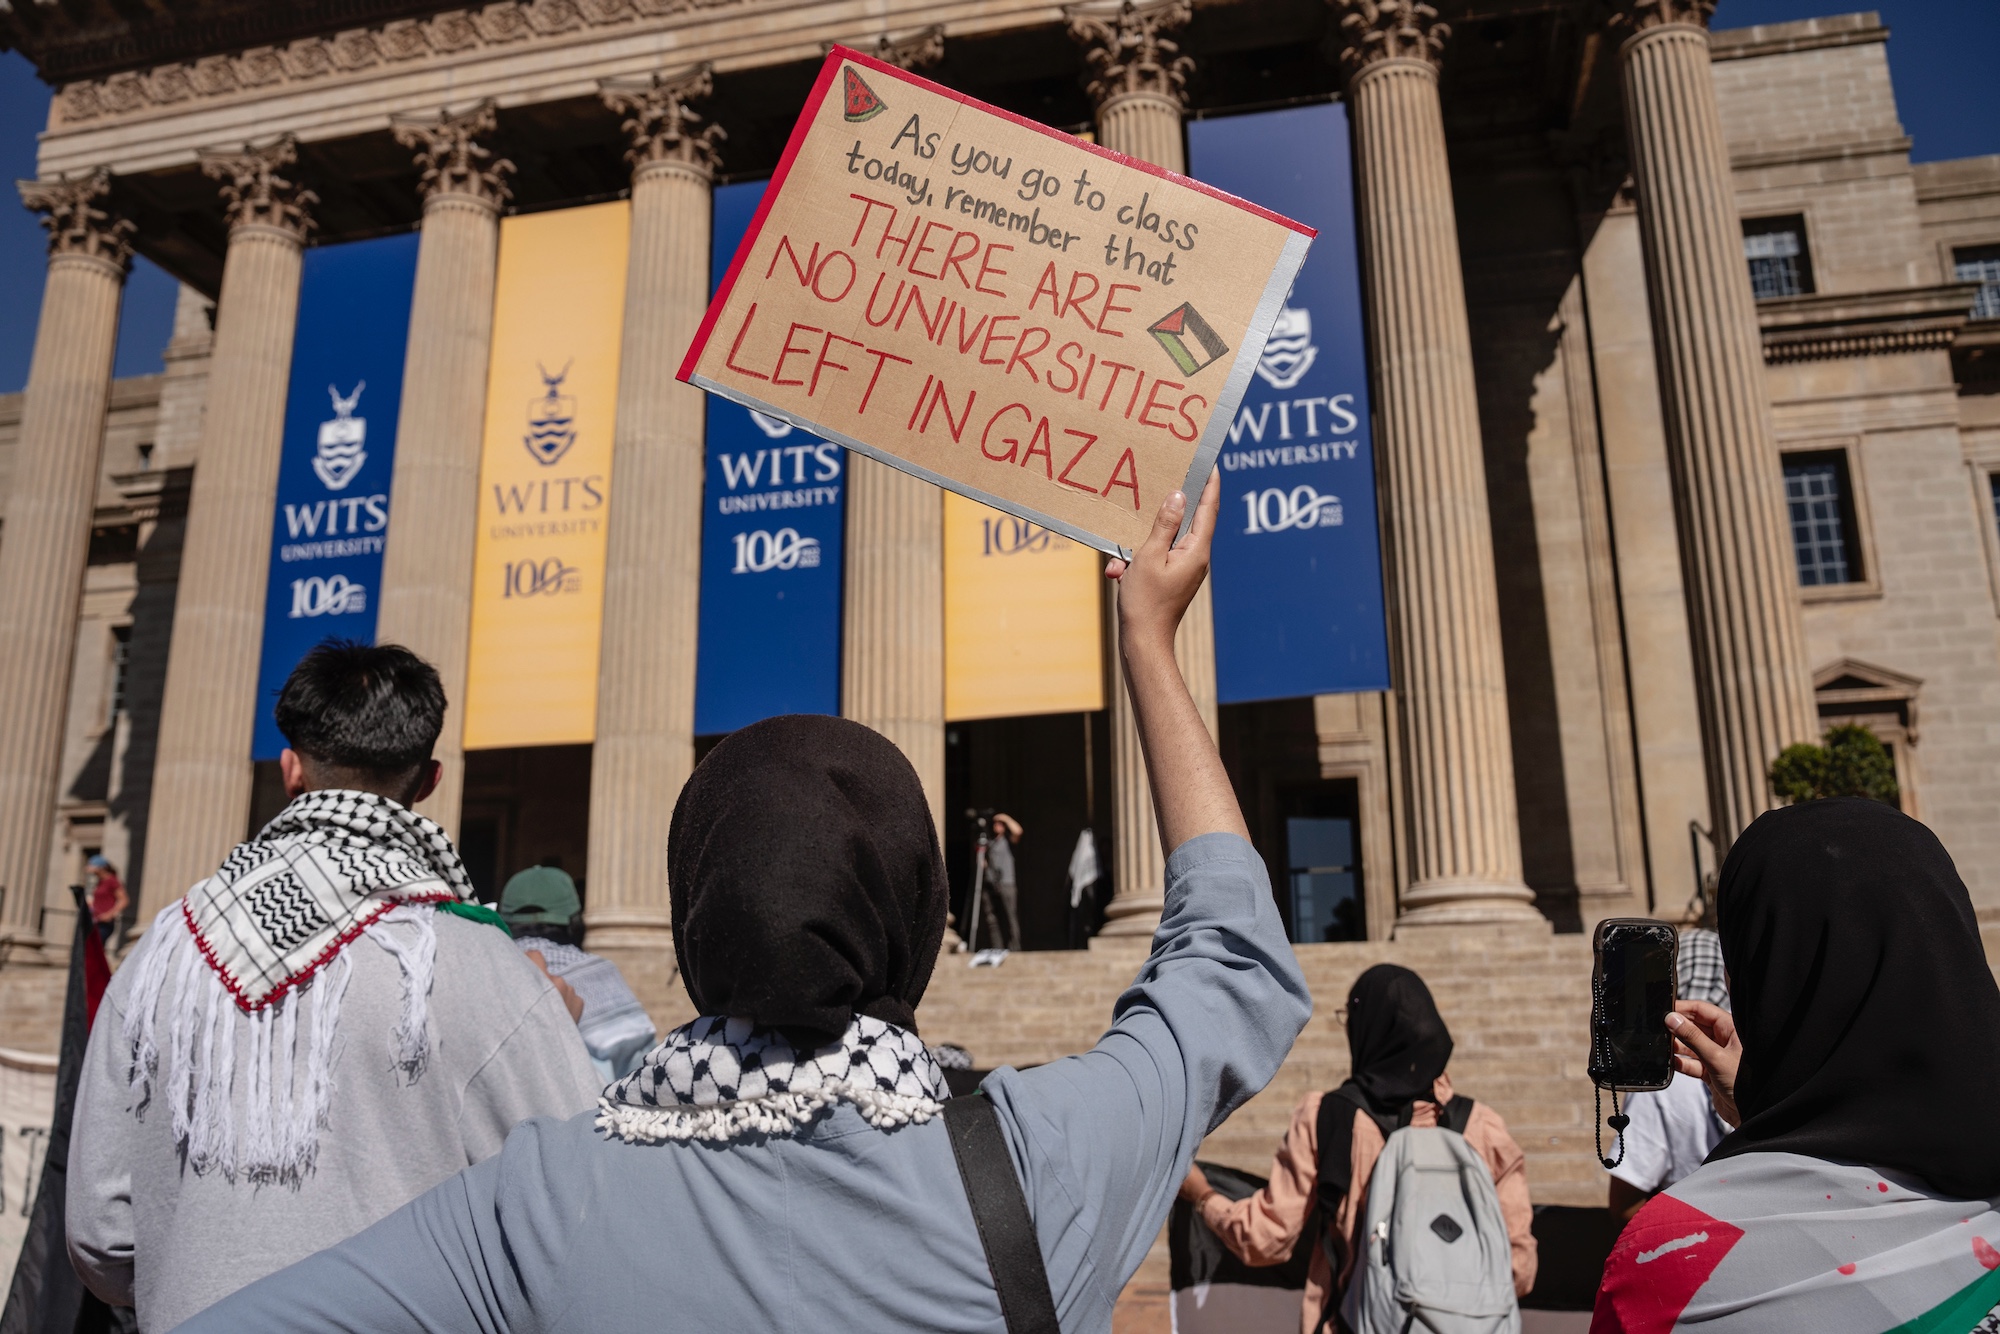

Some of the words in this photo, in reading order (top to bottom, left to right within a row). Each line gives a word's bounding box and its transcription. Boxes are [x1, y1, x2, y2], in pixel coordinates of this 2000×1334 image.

[890, 113, 941, 159] As
[951, 143, 1012, 180] you
[1017, 168, 1061, 201] go
[1073, 169, 1106, 211] to
[1117, 192, 1199, 250] class
[846, 140, 933, 206] today,
[945, 186, 1081, 252] remember
[1104, 234, 1177, 286] that
[849, 193, 1014, 299] THERE
[1028, 260, 1142, 338] ARE
[765, 235, 857, 303] NO
[865, 271, 1208, 442] UNIVERSITIES
[726, 302, 913, 414] LEFT
[908, 374, 977, 444] IN
[981, 402, 1141, 511] GAZA
[1228, 393, 1359, 446] WITS
[717, 442, 840, 491] WITS
[1223, 439, 1359, 472] UNIVERSITY
[283, 494, 388, 540] WITS
[493, 474, 604, 516] WITS
[717, 485, 840, 515] UNIVERSITY
[1241, 484, 1340, 535] 100
[280, 535, 386, 563] UNIVERSITY
[489, 518, 603, 541] UNIVERSITY
[731, 527, 820, 575] 100
[287, 574, 366, 619] 100
[502, 556, 580, 600] 100
